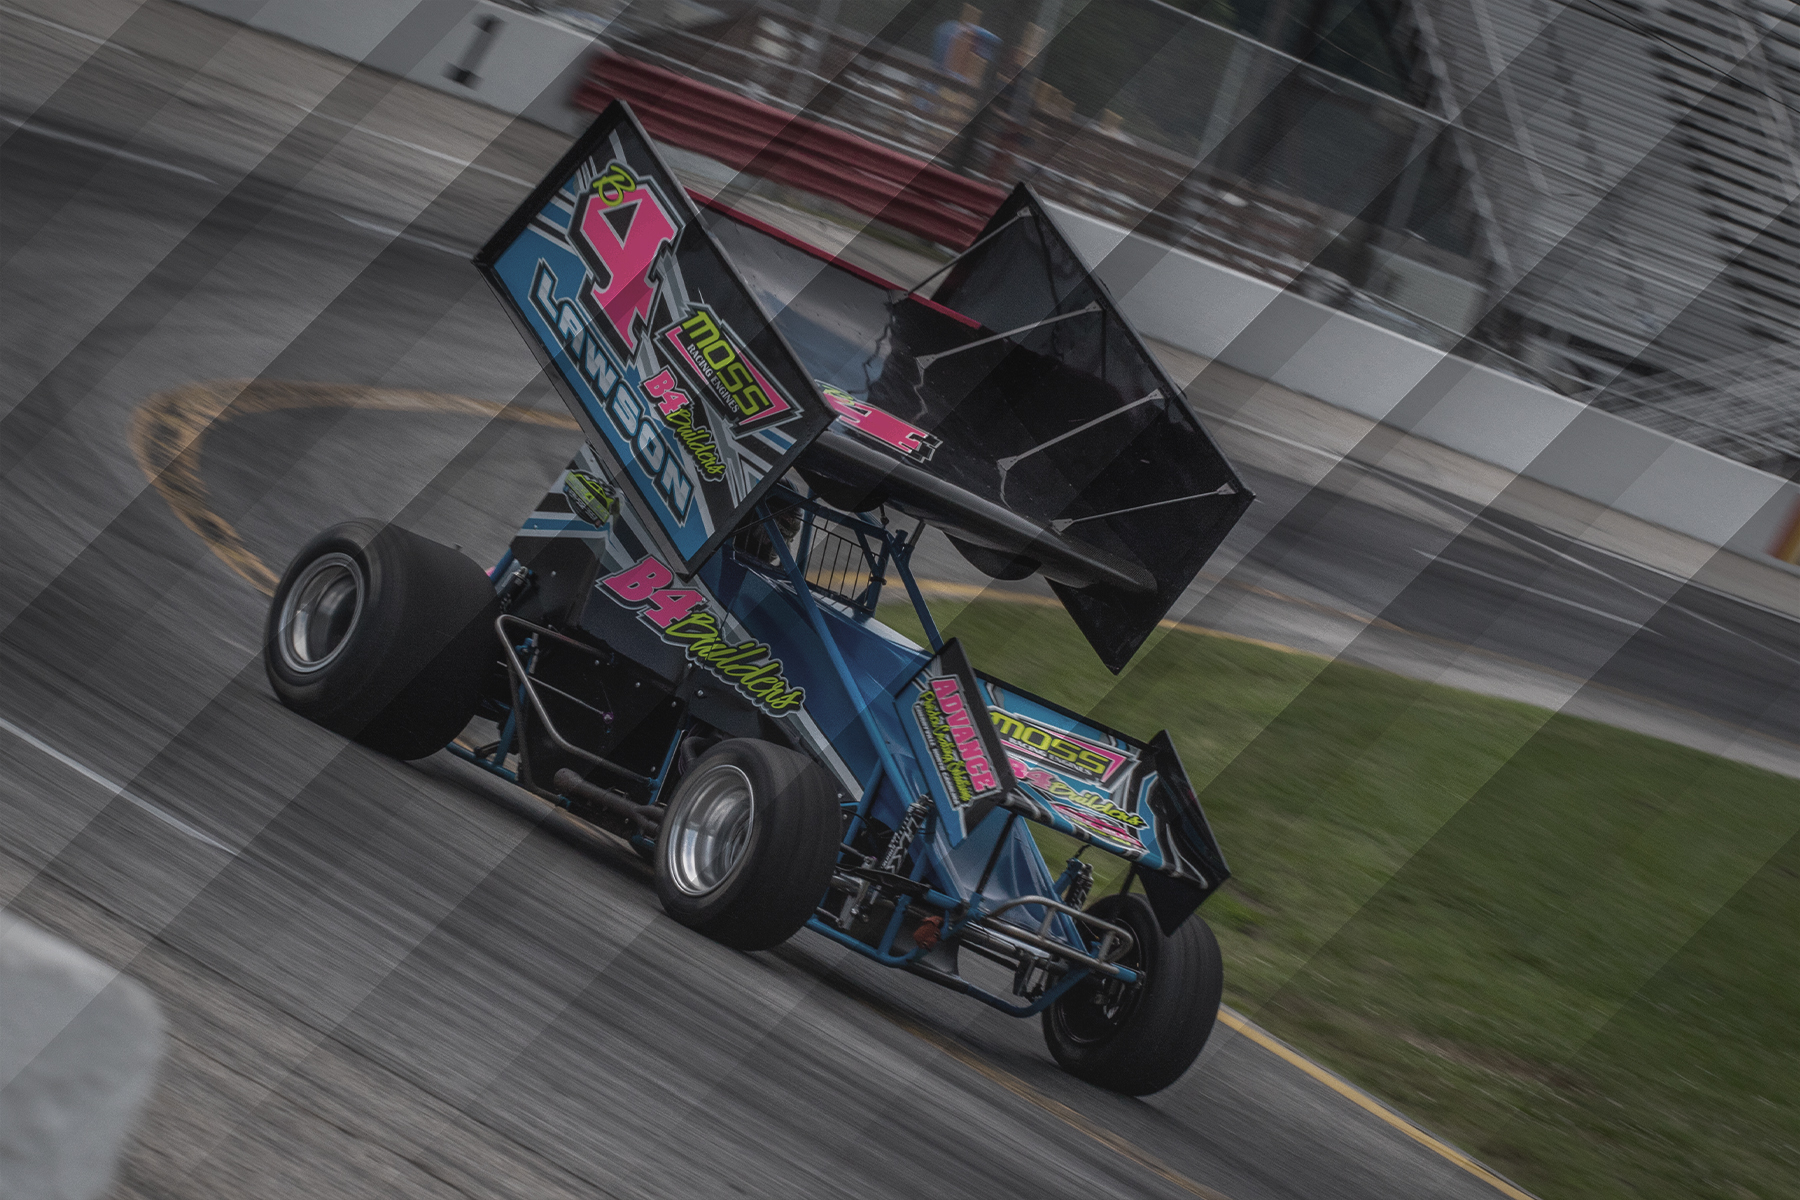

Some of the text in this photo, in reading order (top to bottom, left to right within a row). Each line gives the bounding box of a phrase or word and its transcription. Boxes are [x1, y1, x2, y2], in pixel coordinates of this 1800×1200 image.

[592, 165, 637, 207] B
[580, 183, 678, 350] 4
[536, 267, 693, 517] LAWSON
[682, 310, 770, 416] MOSS
[687, 343, 740, 414] RACING ENGINES
[643, 369, 727, 475] B4 Builders
[603, 555, 803, 709] B4 Builders
[931, 678, 997, 793] ADVANCE
[989, 711, 1109, 775] MOSS
[1048, 782, 1144, 826] Builders
